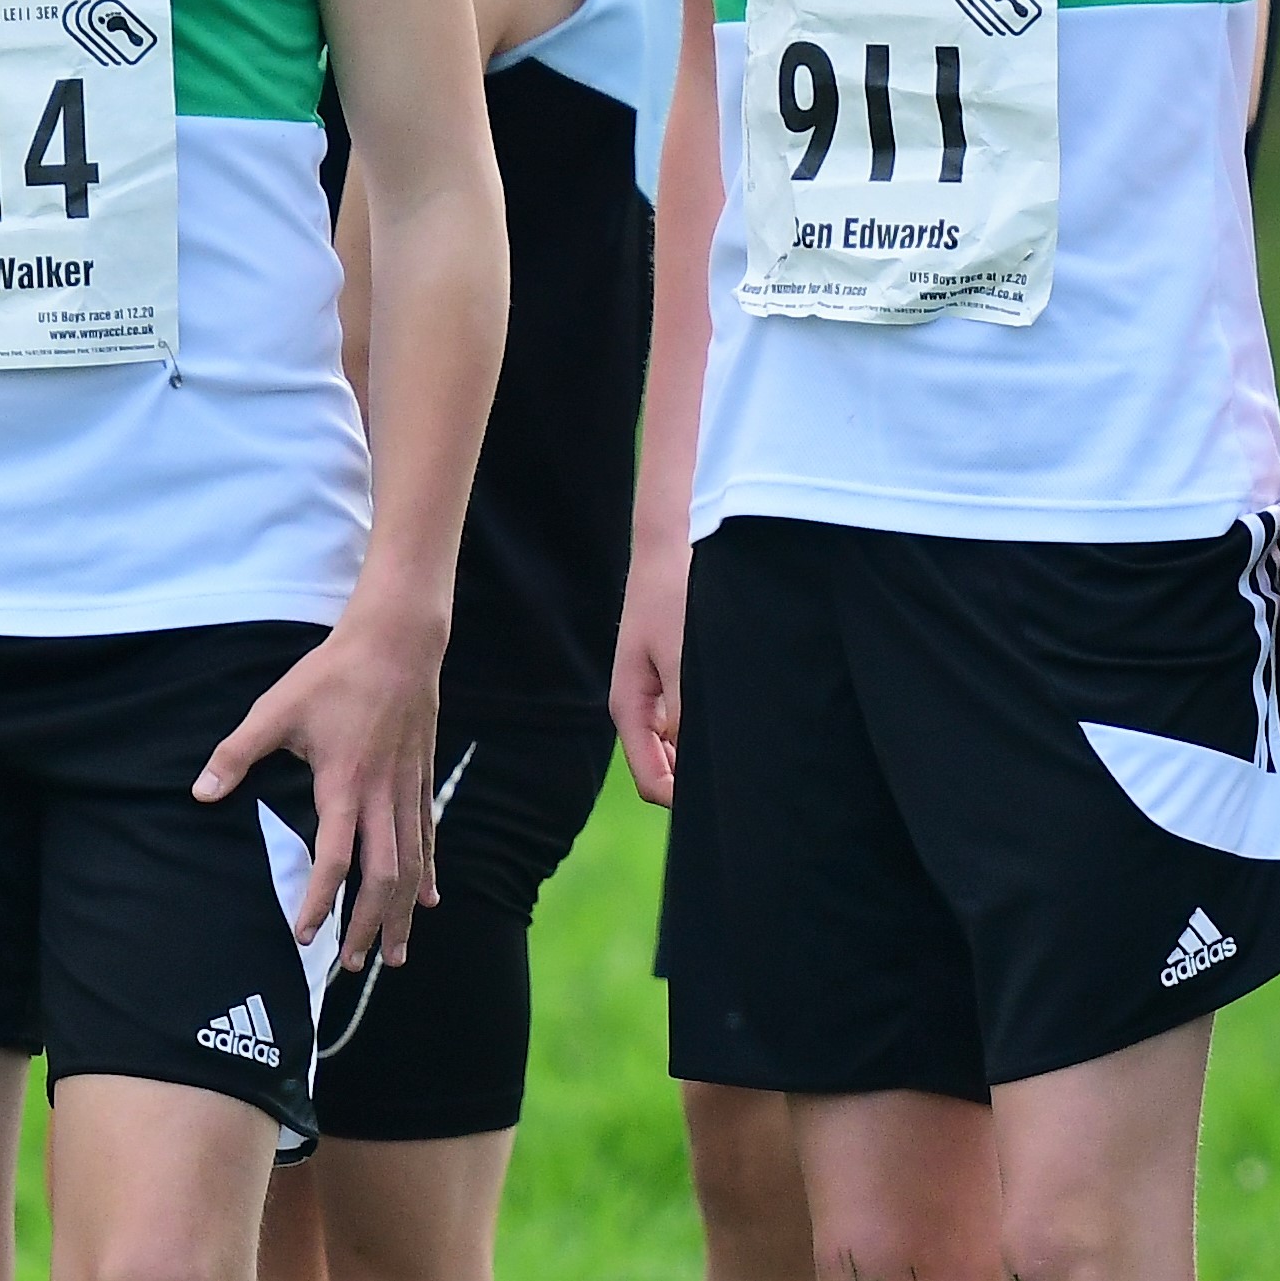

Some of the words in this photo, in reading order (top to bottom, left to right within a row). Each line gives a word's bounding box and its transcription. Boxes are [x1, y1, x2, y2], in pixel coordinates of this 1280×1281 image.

[36, 6, 59, 20] 3ER
[778, 41, 967, 183] 911
[843, 217, 960, 250] Edwards
[910, 272, 929, 284] U15
[933, 273, 957, 286] Boys
[960, 273, 982, 284] race
[986, 272, 996, 282] at
[38, 311, 57, 323] U15
[89, 310, 111, 322] race
[1160, 937, 1237, 987] adidas
[196, 1028, 281, 1068] adidas
